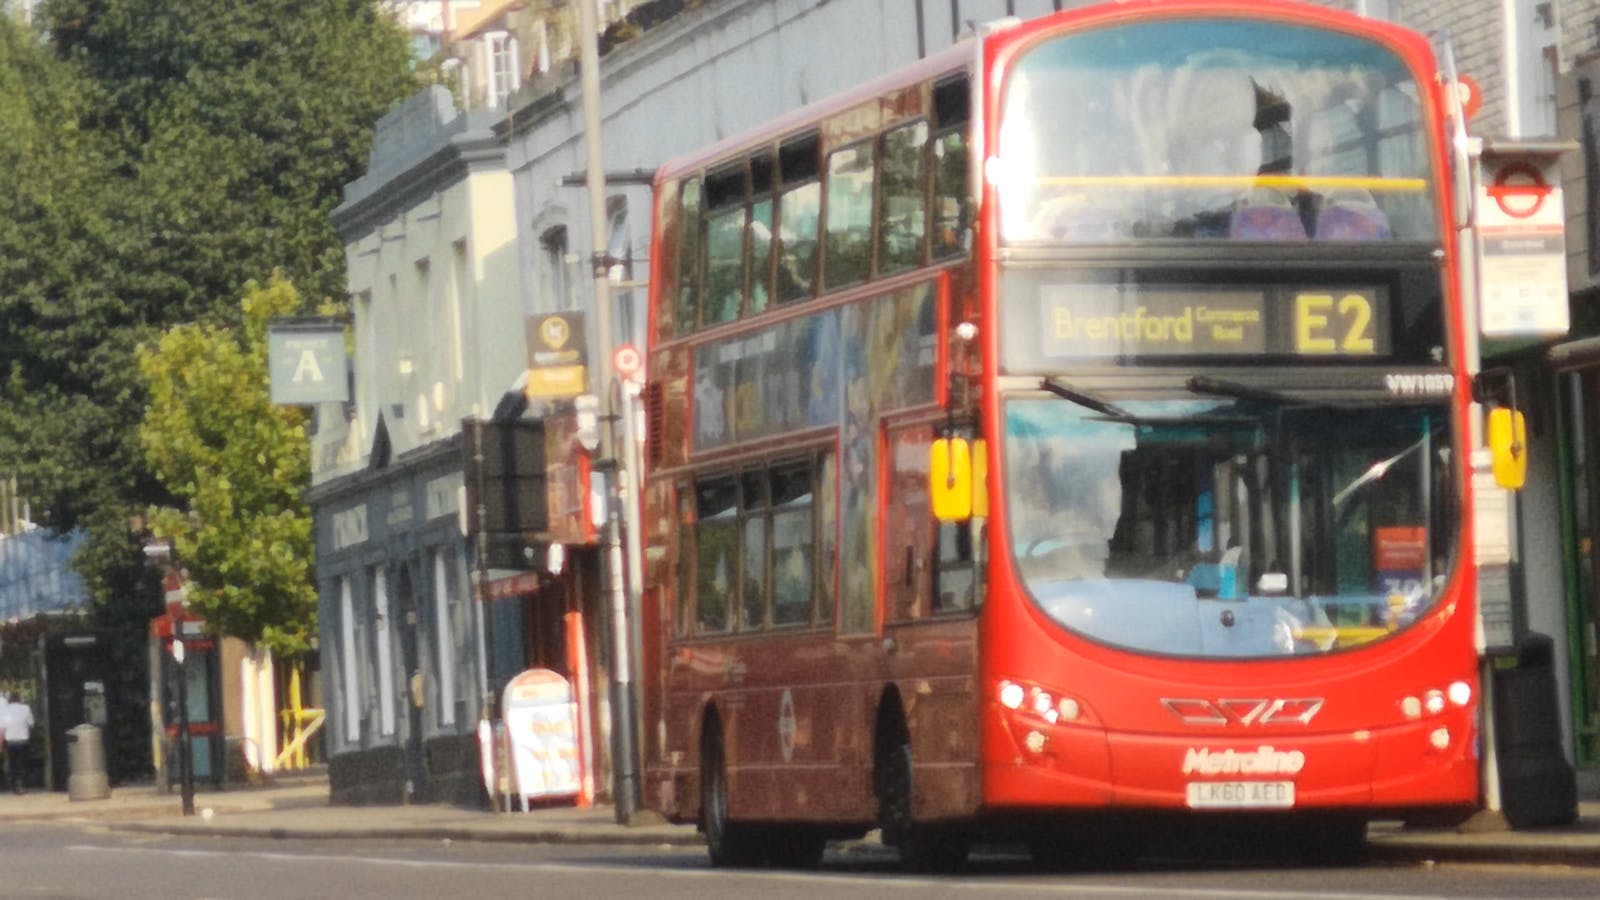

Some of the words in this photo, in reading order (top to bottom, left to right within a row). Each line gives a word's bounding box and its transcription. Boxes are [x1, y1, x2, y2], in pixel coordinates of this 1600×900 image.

[1054, 306, 1194, 342] Brentford
[1295, 294, 1375, 354] E2
[292, 350, 324, 382] A
[1183, 745, 1305, 775] Metroline
[1197, 783, 1246, 801] LK60
